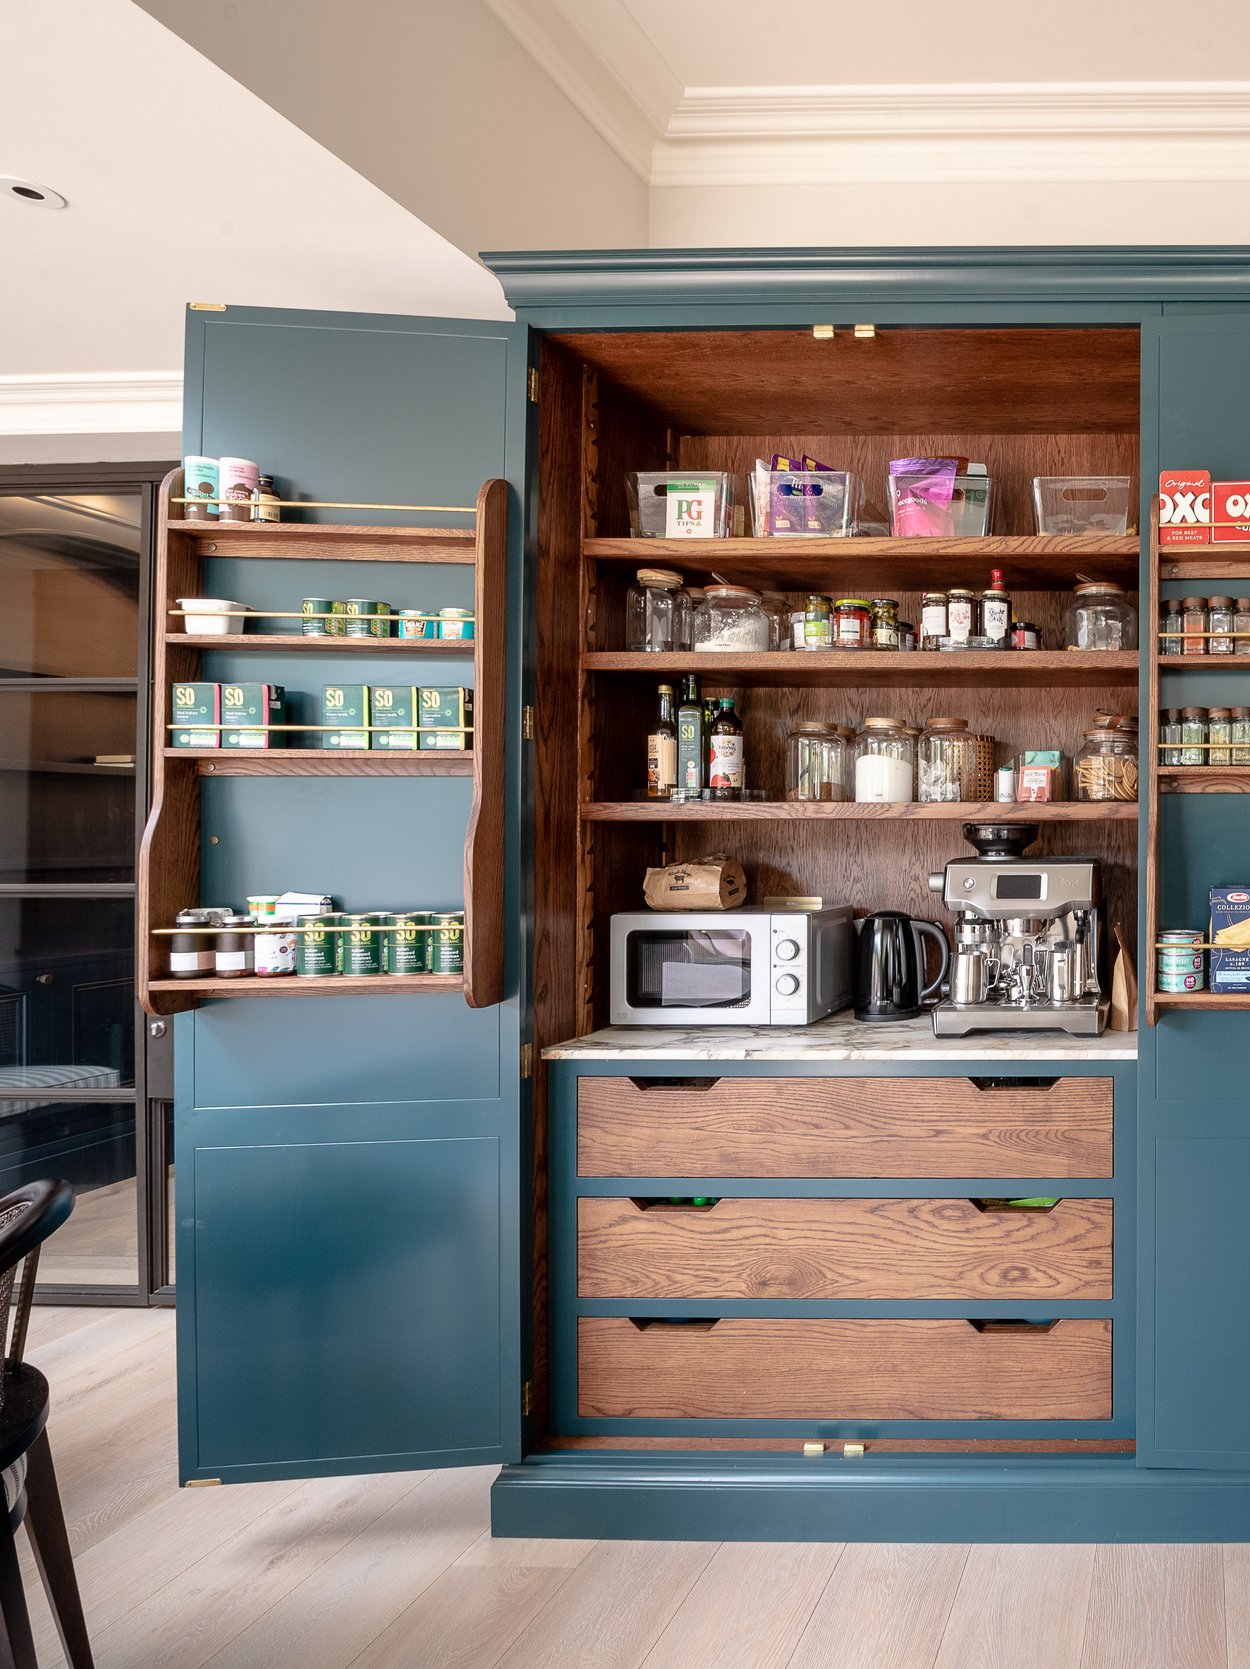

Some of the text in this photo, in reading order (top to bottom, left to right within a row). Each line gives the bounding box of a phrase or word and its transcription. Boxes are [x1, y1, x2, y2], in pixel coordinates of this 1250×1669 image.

[1165, 479, 1205, 489] Original
[676, 500, 703, 520] PG
[176, 688, 195, 705] SO
[225, 688, 243, 705] SO
[326, 690, 343, 706] SO
[375, 691, 392, 706] SO
[423, 692, 440, 707] SO
[682, 726, 694, 738] SO
